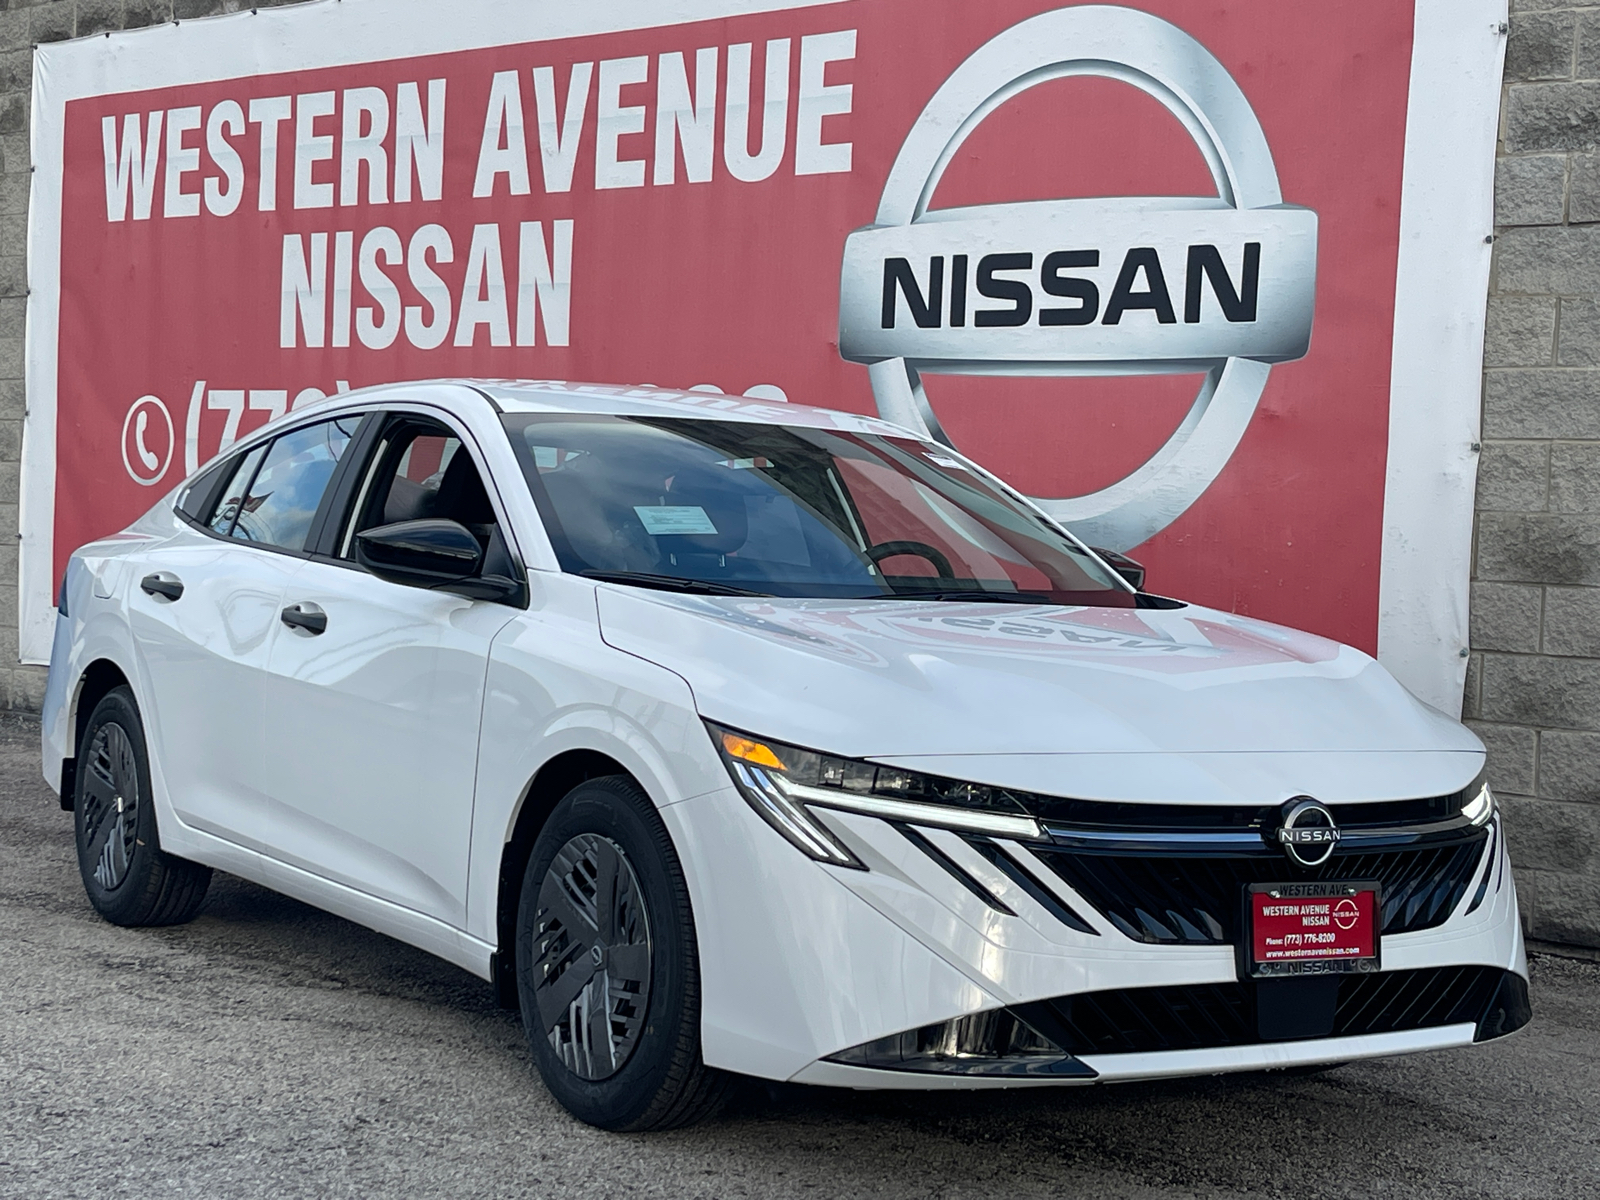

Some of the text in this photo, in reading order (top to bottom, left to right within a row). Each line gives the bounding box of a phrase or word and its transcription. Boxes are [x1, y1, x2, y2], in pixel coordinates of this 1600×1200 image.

[102, 29, 858, 222] WESTERN AVENUE
[280, 219, 574, 349] NISSAN
[882, 242, 1261, 328] NISSAN
[1281, 829, 1341, 842] NISSAN
[1280, 885, 1327, 896] WESTERN
[1262, 905, 1330, 916] WESTERN AVENUE
[1302, 916, 1330, 926] NISSAN
[1265, 932, 1335, 946] Phone: (773) 776-8200
[1265, 947, 1360, 958] www.westernavenissan.com
[1288, 960, 1344, 975] NISSAN
